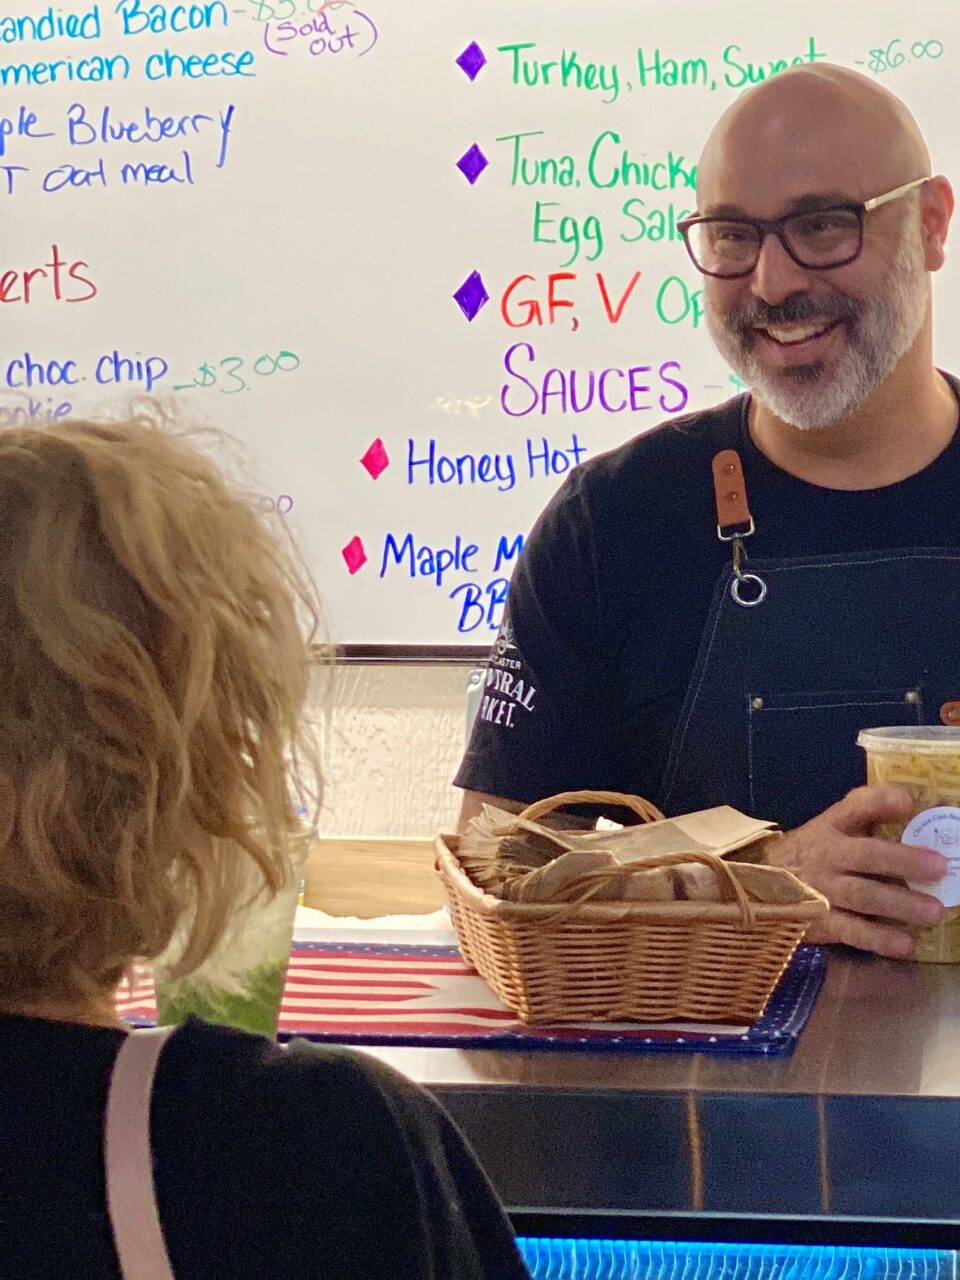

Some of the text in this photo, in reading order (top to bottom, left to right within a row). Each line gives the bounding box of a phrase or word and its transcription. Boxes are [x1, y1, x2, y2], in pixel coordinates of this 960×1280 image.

[0, 4, 101, 43] andied
[0, 55, 130, 86] merican
[67, 103, 235, 169] Blueberry
[533, 200, 604, 268] Egg
[596, 271, 642, 324] V
[501, 342, 689, 417] SAUCES
[407, 433, 588, 492] Honey Hot
[379, 532, 479, 587] Maple
